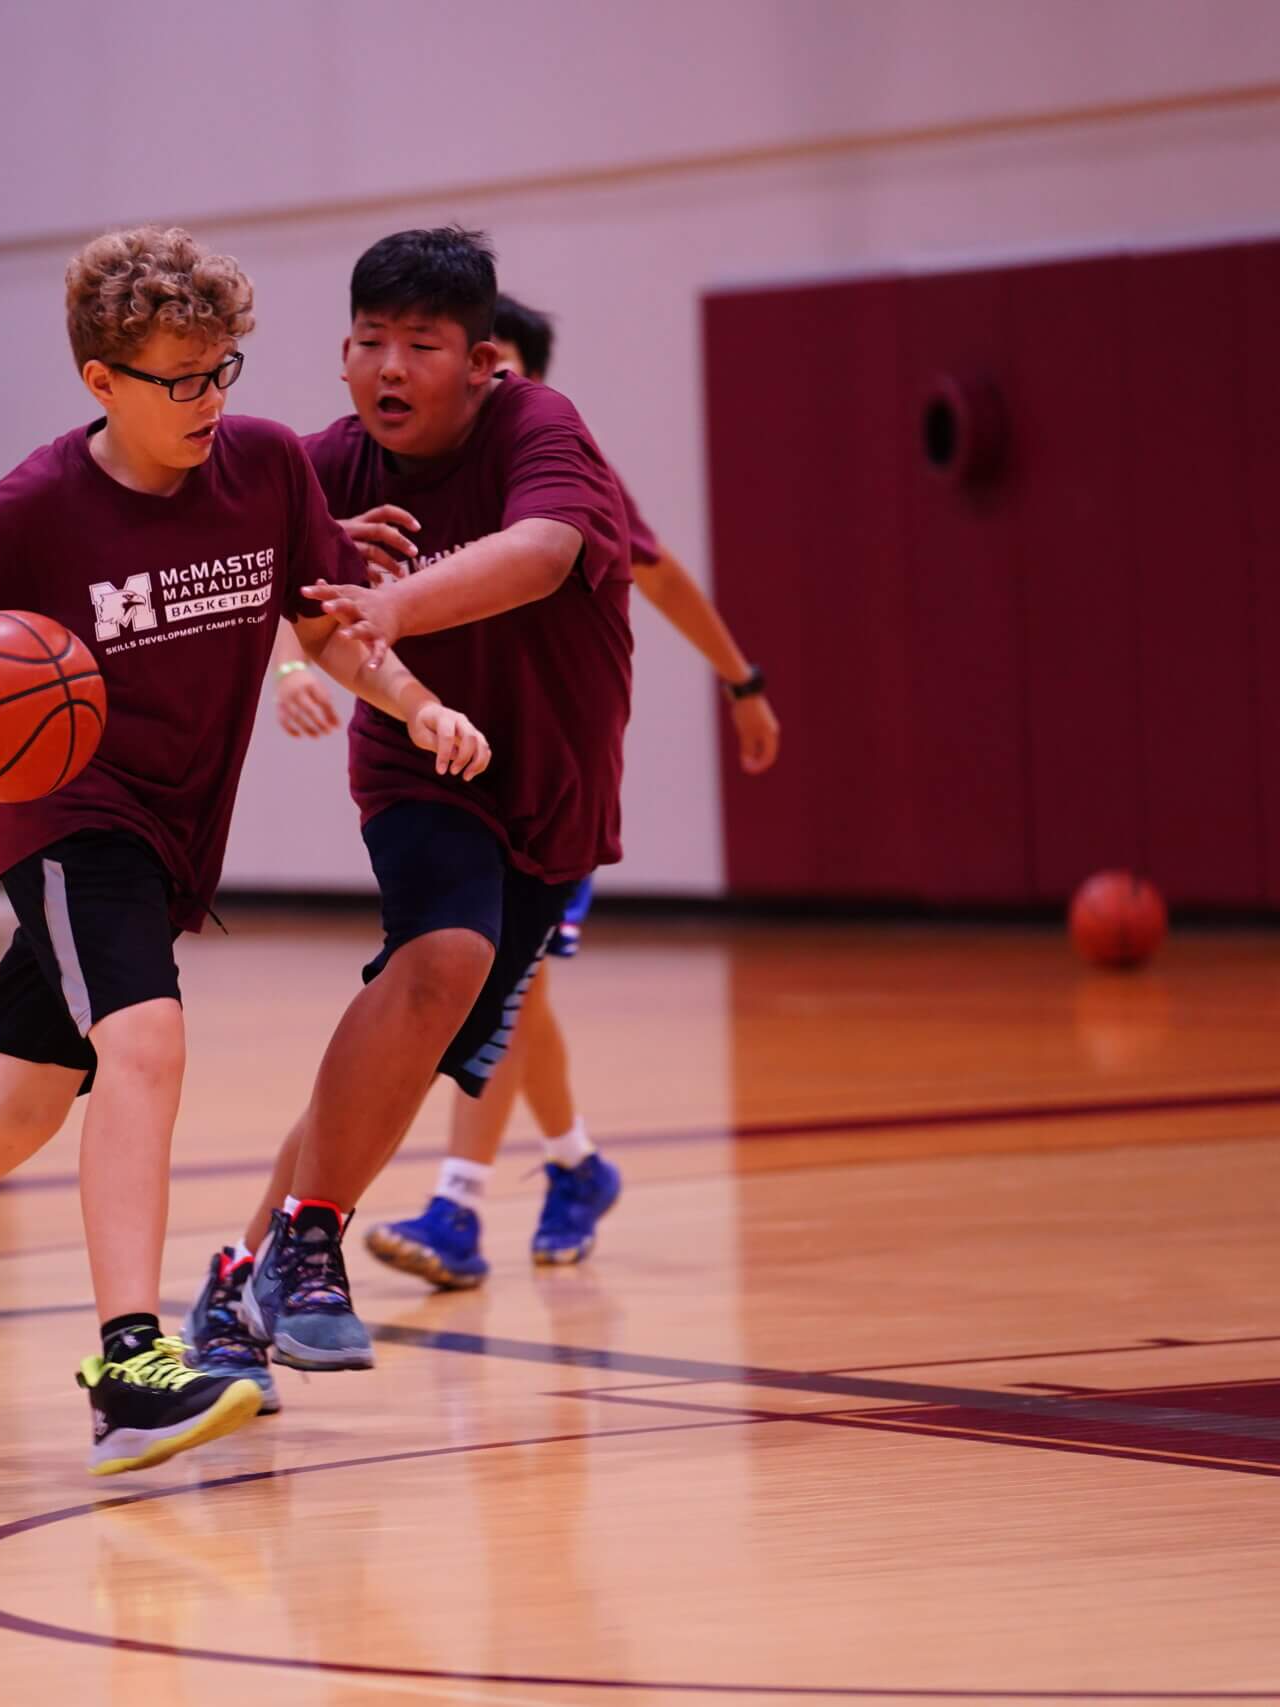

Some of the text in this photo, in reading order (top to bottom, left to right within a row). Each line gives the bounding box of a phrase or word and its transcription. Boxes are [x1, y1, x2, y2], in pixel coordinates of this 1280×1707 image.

[159, 547, 274, 587] McMASTER
[163, 566, 273, 602] MARAUDERS
[105, 640, 137, 656] SKILLS
[139, 625, 204, 647] DEVELOPMENT
[206, 617, 237, 632] CAMPS
